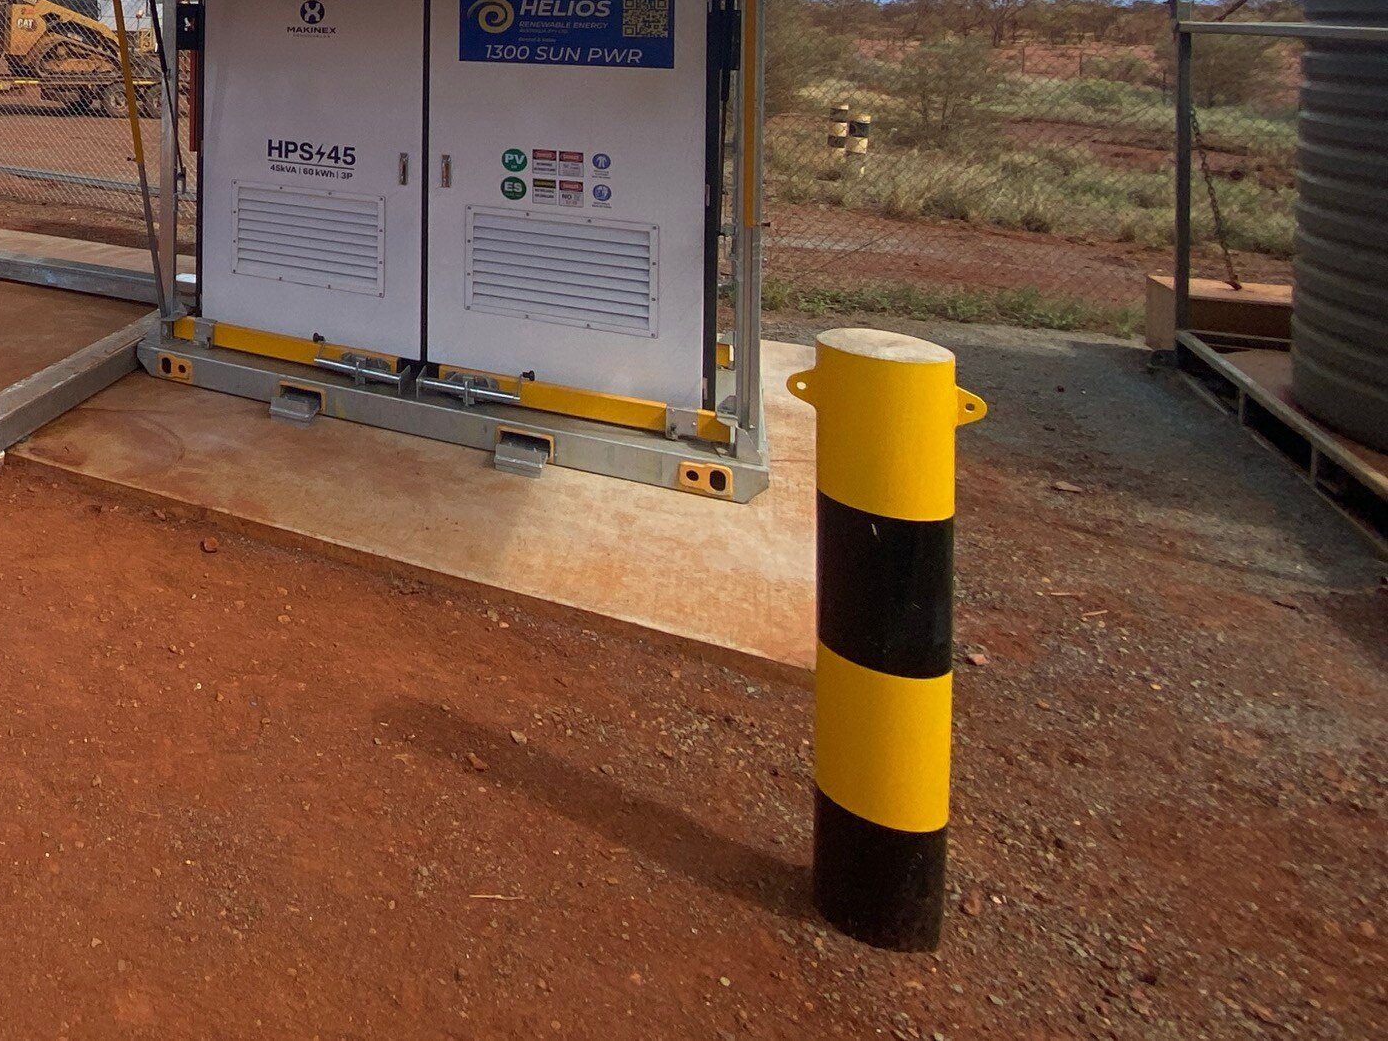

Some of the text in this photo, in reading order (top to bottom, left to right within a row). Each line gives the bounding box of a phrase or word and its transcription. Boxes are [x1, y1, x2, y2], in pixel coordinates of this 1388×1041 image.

[519, 0, 612, 17] HELIOS
[17, 18, 34, 29] CAT
[518, 21, 609, 29] RENEWABLE ENERGY
[286, 26, 337, 34] MAKINEX
[485, 44, 643, 64] 1300 SUN PWR
[504, 153, 526, 165] PV
[270, 164, 353, 180] 45kVA 60 kWh 3P
[504, 181, 523, 193] ES
